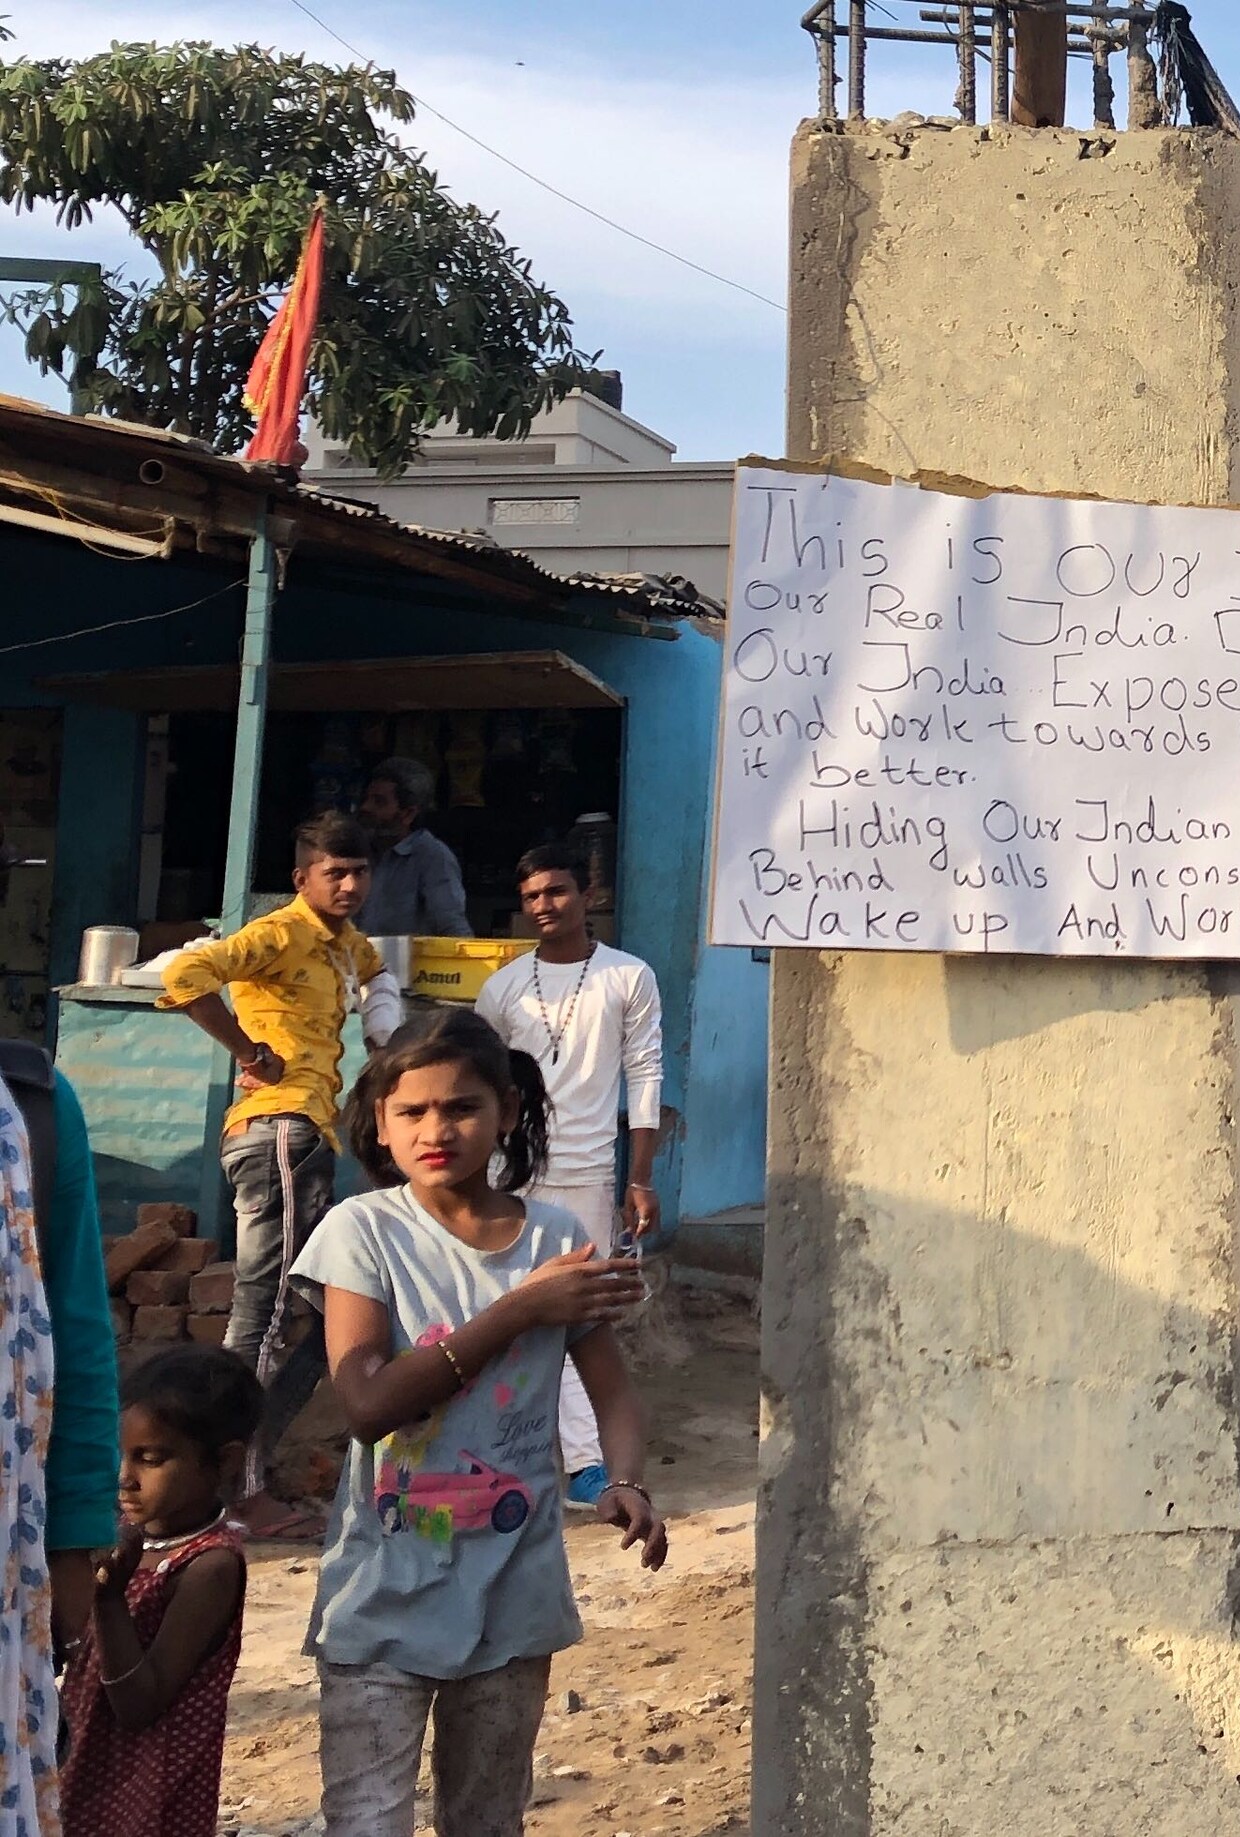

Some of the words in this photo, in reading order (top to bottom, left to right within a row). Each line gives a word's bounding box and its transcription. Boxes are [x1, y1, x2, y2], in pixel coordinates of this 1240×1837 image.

[747, 486, 888, 577] This
[946, 522, 1004, 584] is
[744, 580, 829, 614] Our
[865, 583, 965, 631] Real
[997, 595, 1189, 646] India.
[733, 628, 833, 682] Our
[738, 695, 837, 742] and
[988, 713, 1211, 755] towards
[742, 746, 769, 779] it
[810, 750, 977, 788] better.
[800, 798, 949, 871] Hiding
[982, 799, 1063, 843] Our
[1075, 795, 1231, 845] Indian
[750, 848, 895, 896] Behind
[952, 853, 1048, 889] walls
[739, 893, 923, 942] Wake
[952, 913, 1009, 951] up
[1057, 902, 1127, 941] And
[414, 970, 461, 985] Amul
[491, 1411, 547, 1449] Love
